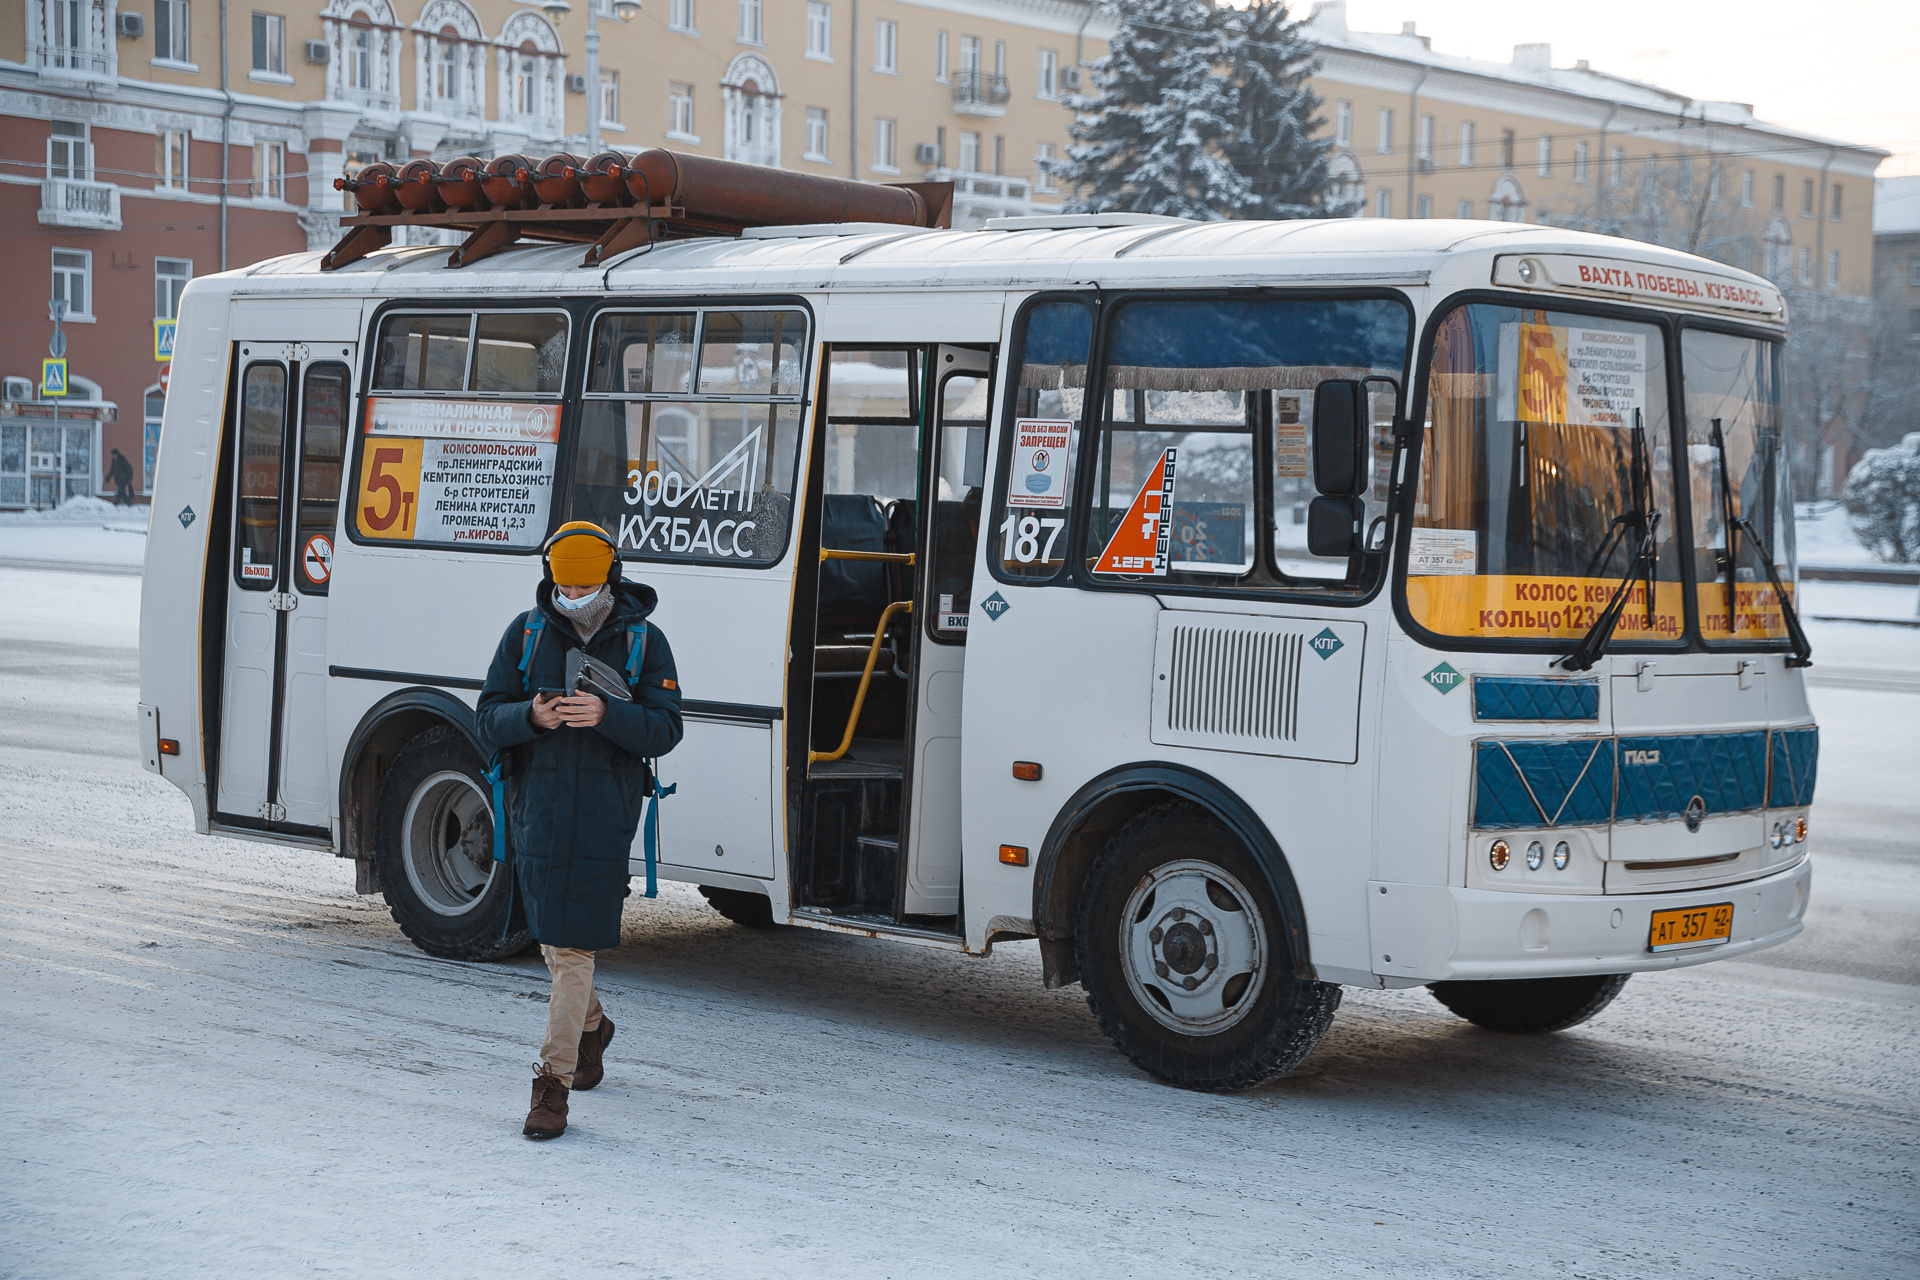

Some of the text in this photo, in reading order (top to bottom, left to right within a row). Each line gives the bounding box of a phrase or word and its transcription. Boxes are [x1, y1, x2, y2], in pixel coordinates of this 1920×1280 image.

[1578, 265, 1764, 306] ВАХТА ПОБЕДЫ. КУЗБАСС
[410, 402, 512, 420] БЕЗНАЛИЧНАЯ
[397, 419, 521, 438] ОПЛАТА ПРОЕЗДА
[1020, 425, 1037, 434] ВХОД
[1037, 425, 1047, 433] БЕЗ
[1020, 435, 1066, 449] ЗАПРЕЩЕН
[442, 443, 537, 457] КОМСОМОЛЬСКИЙ
[437, 458, 542, 472] пр.ЛЕНИНГРАДСКИЙ
[423, 472, 472, 484] КЕМТИПП
[444, 487, 529, 500] б-р СТРОИТЕЛЕЙ
[623, 468, 735, 511] 300 ЛЕТ
[435, 501, 536, 514] ЛЕНИНА КРИСТАЛЛ
[1154, 448, 1177, 569] КЕМЕРОВО
[180, 512, 194, 521] КПГ
[441, 515, 526, 530] ПРОМЕНАД 1,2,3
[453, 529, 510, 542] ул.КИРОВА
[617, 514, 756, 557] КУЗБАСС
[1000, 514, 1065, 564] 187
[244, 566, 270, 578] ВЫХОД
[985, 599, 1005, 612] КПГ
[948, 616, 969, 628] ВХО
[1314, 637, 1338, 650] КПГ
[1430, 671, 1458, 684] КПГ
[1625, 750, 1660, 765] ПАЗ
[1681, 911, 1708, 938] 357
[1714, 908, 1728, 927] 42
